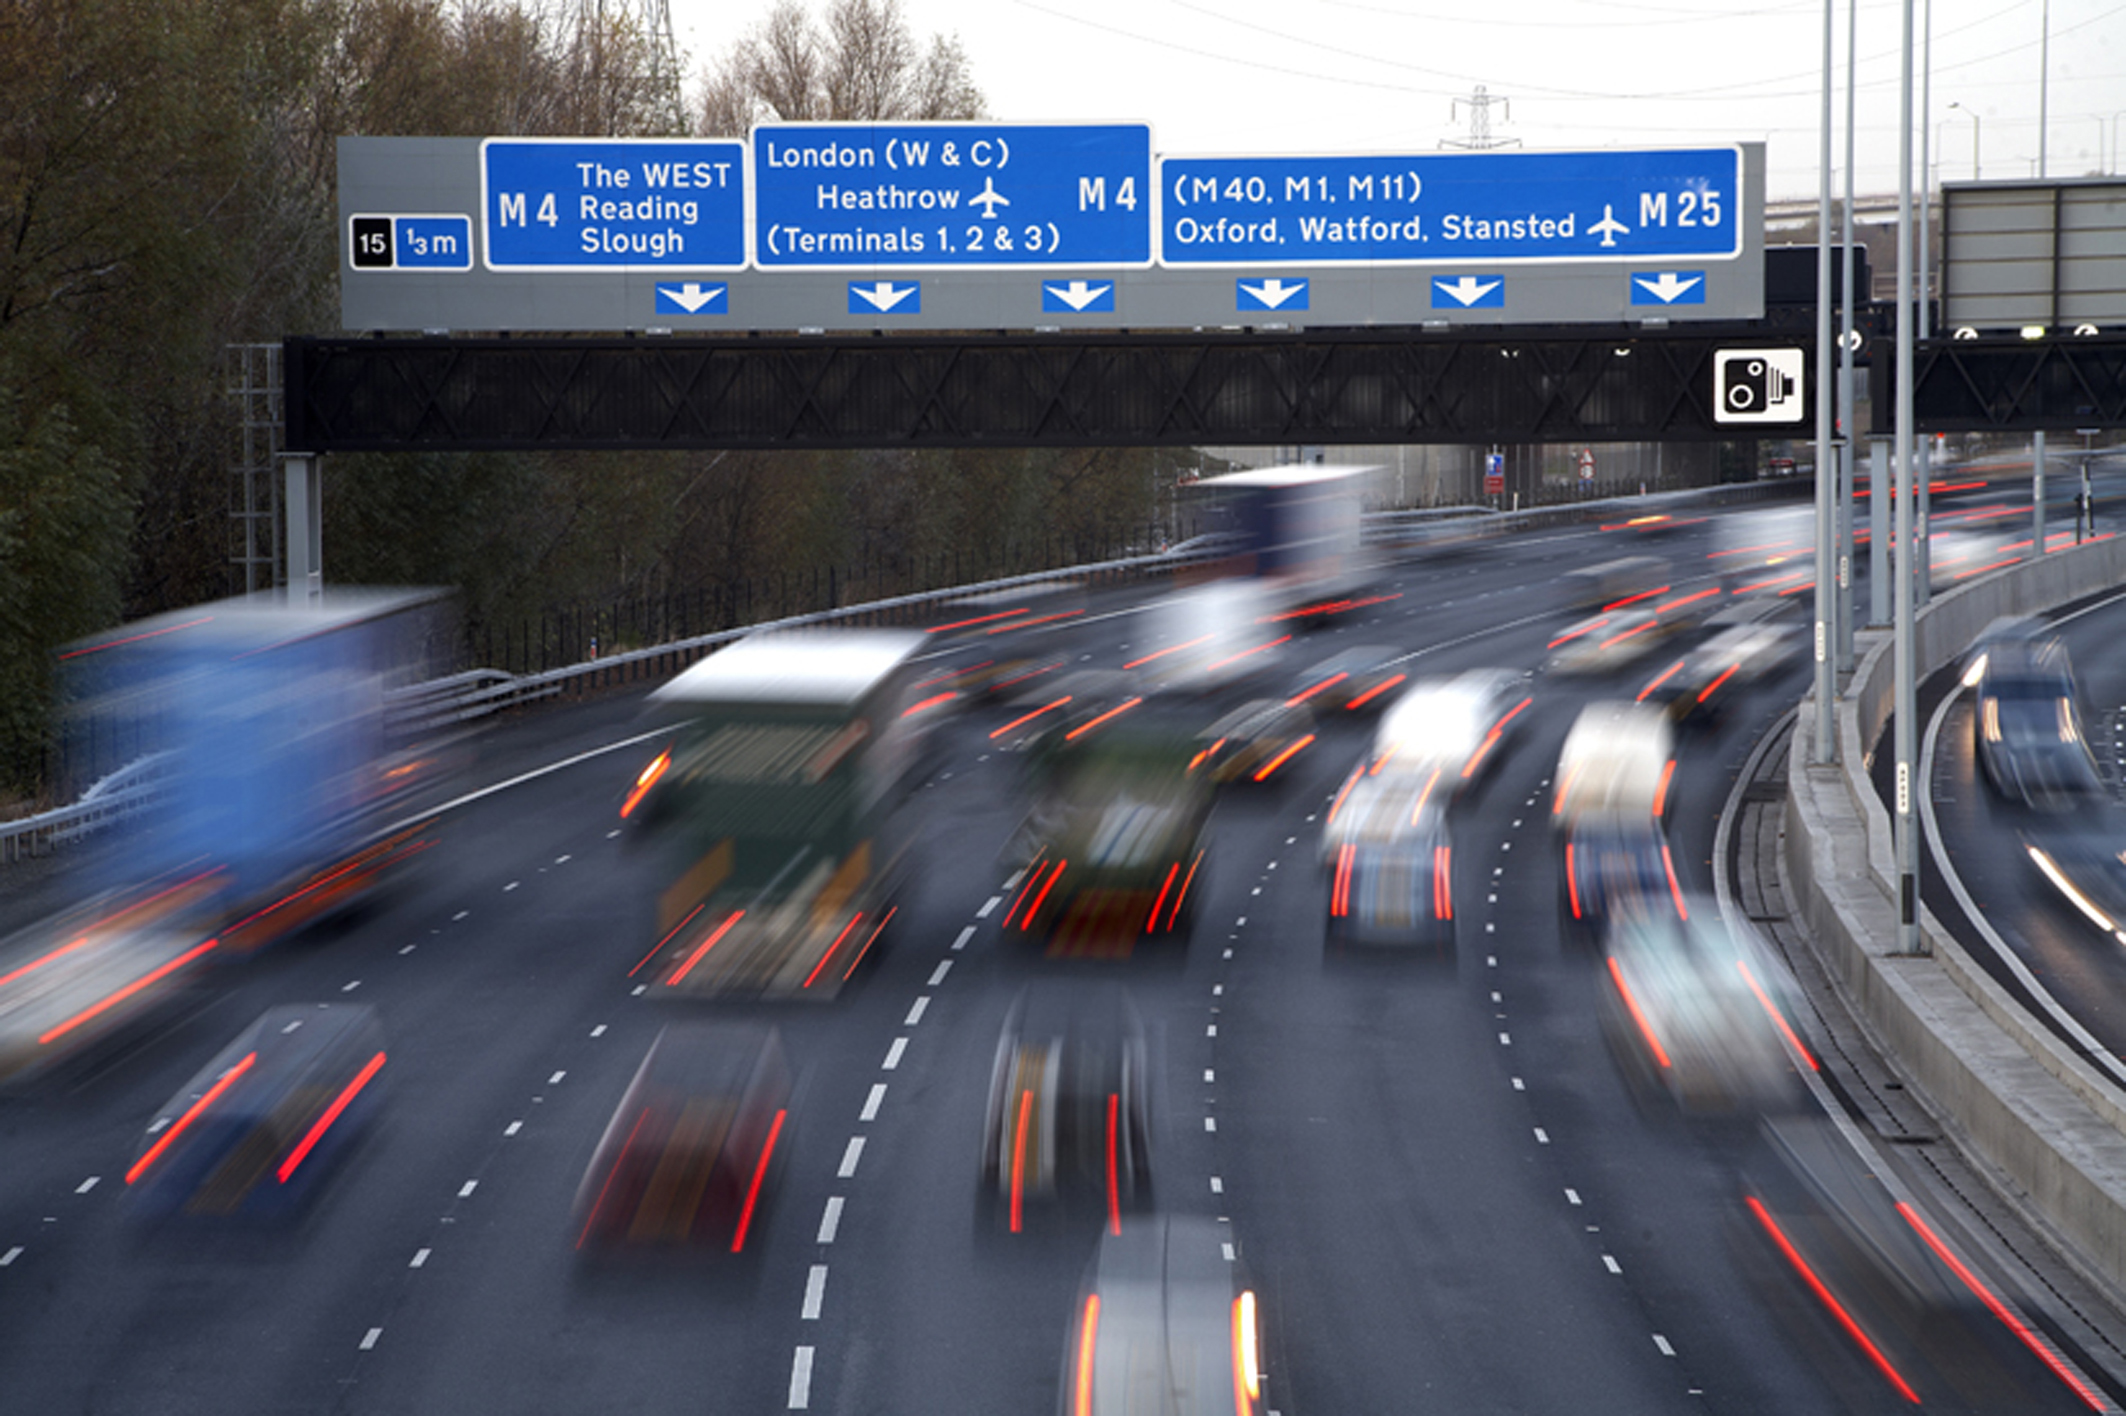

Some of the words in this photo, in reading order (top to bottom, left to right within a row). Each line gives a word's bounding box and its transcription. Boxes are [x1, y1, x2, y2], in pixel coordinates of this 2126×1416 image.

[768, 142, 875, 168] London
[885, 138, 930, 170] (W
[941, 142, 961, 166] &
[970, 138, 1009, 169] C)
[576, 163, 631, 188] The
[642, 163, 731, 188] WEST
[580, 195, 698, 225] Reading
[817, 184, 960, 210] Heathrow
[581, 228, 683, 257] Slough
[767, 225, 925, 254] (Terminals
[937, 226, 956, 253] 1,
[966, 225, 984, 251] 2
[993, 225, 1014, 251] &
[1024, 222, 1060, 254] 3)
[1175, 217, 1285, 244] Oxford,
[1299, 215, 1428, 242] Watford,
[1442, 212, 1575, 240] Stansted
[360, 233, 386, 254] 15
